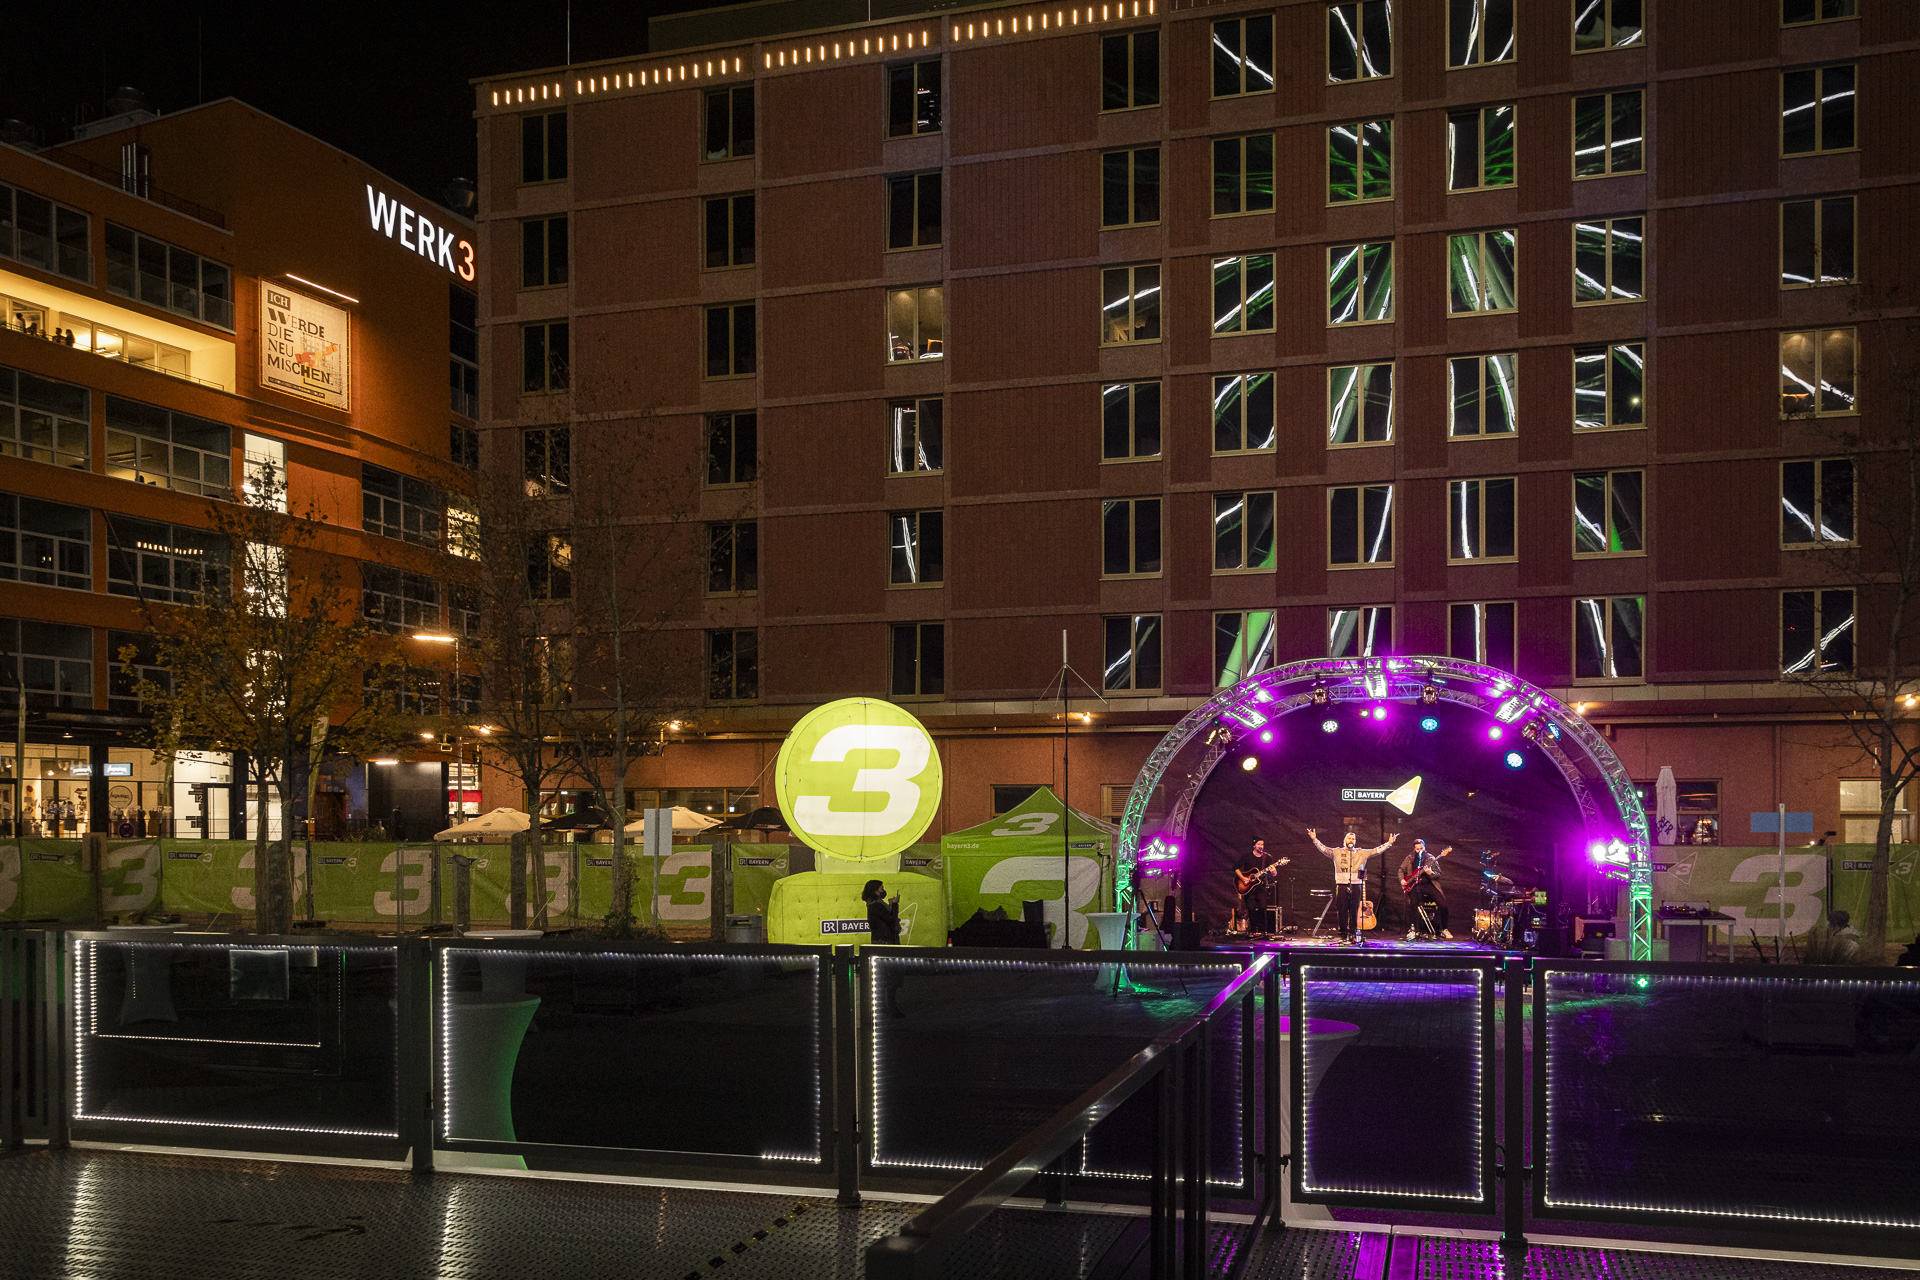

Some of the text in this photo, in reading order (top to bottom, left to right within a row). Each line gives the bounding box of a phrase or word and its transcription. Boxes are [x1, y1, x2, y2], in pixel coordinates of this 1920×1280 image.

[269, 292, 289, 307] ICH
[267, 307, 325, 339] WERDE
[267, 322, 294, 343] DIE
[268, 337, 294, 358] NEU
[267, 353, 334, 386] MISCHEN.
[793, 724, 931, 837] 3
[1344, 790, 1385, 799] BR BAYERN
[991, 812, 1060, 837] 3
[347, 857, 358, 868] 3
[477, 858, 489, 869] 3
[775, 858, 788, 869] 3
[1675, 863, 1692, 876] 3
[1896, 861, 1912, 875] 3
[100, 844, 161, 912] 3
[373, 850, 432, 916] 3
[651, 851, 712, 921] 3
[1718, 854, 1827, 937] 3
[823, 921, 835, 933] BR
[841, 920, 870, 931] BAYER
